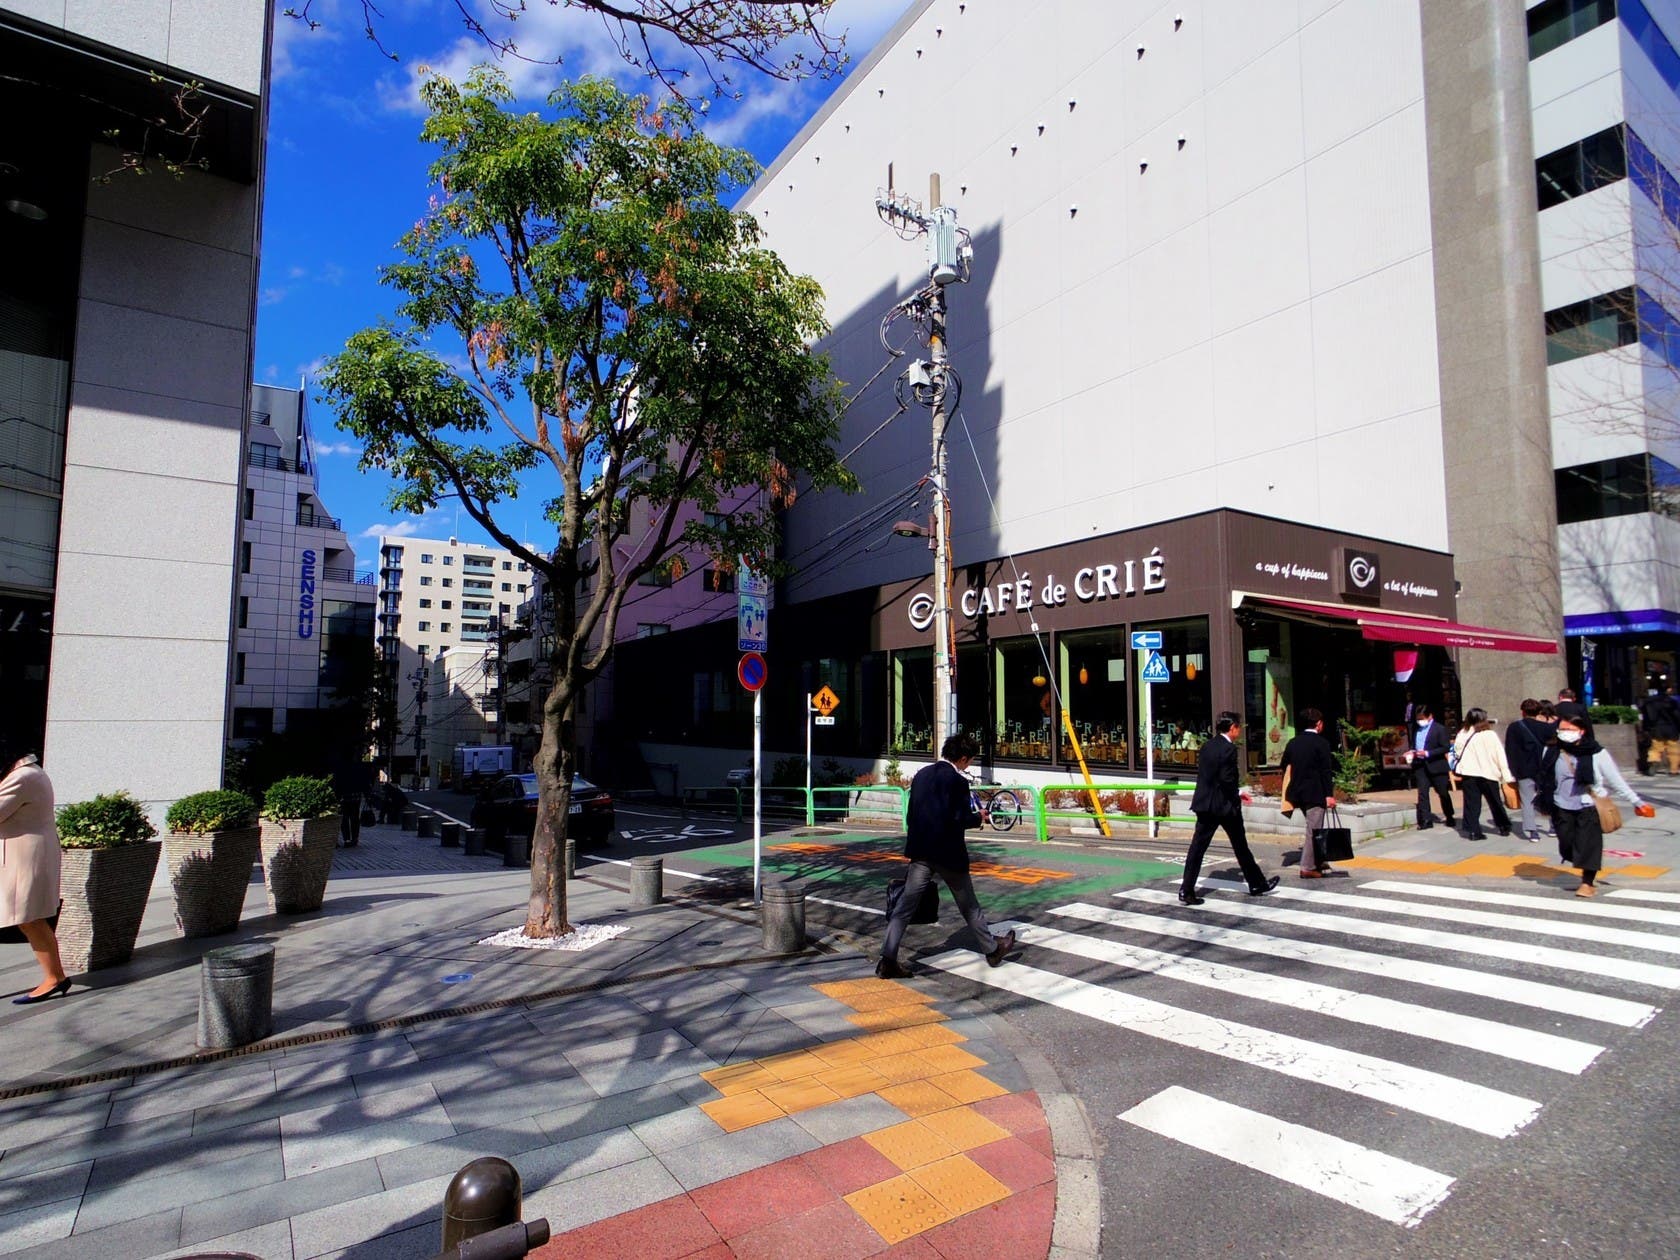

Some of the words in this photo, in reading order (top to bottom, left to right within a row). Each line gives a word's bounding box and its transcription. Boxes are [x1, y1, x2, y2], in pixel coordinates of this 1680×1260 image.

[961, 571, 1033, 617] CAFÉ
[1041, 574, 1067, 606] de
[1074, 547, 1167, 600] CRIÉ
[1255, 562, 1263, 571] a
[1264, 563, 1280, 576] cup
[1281, 563, 1290, 579] of
[1291, 563, 1328, 580] happiness
[1384, 582, 1390, 590] a
[1401, 582, 1408, 596] of
[1409, 582, 1438, 597] happiness
[298, 549, 316, 639] SENSHU
